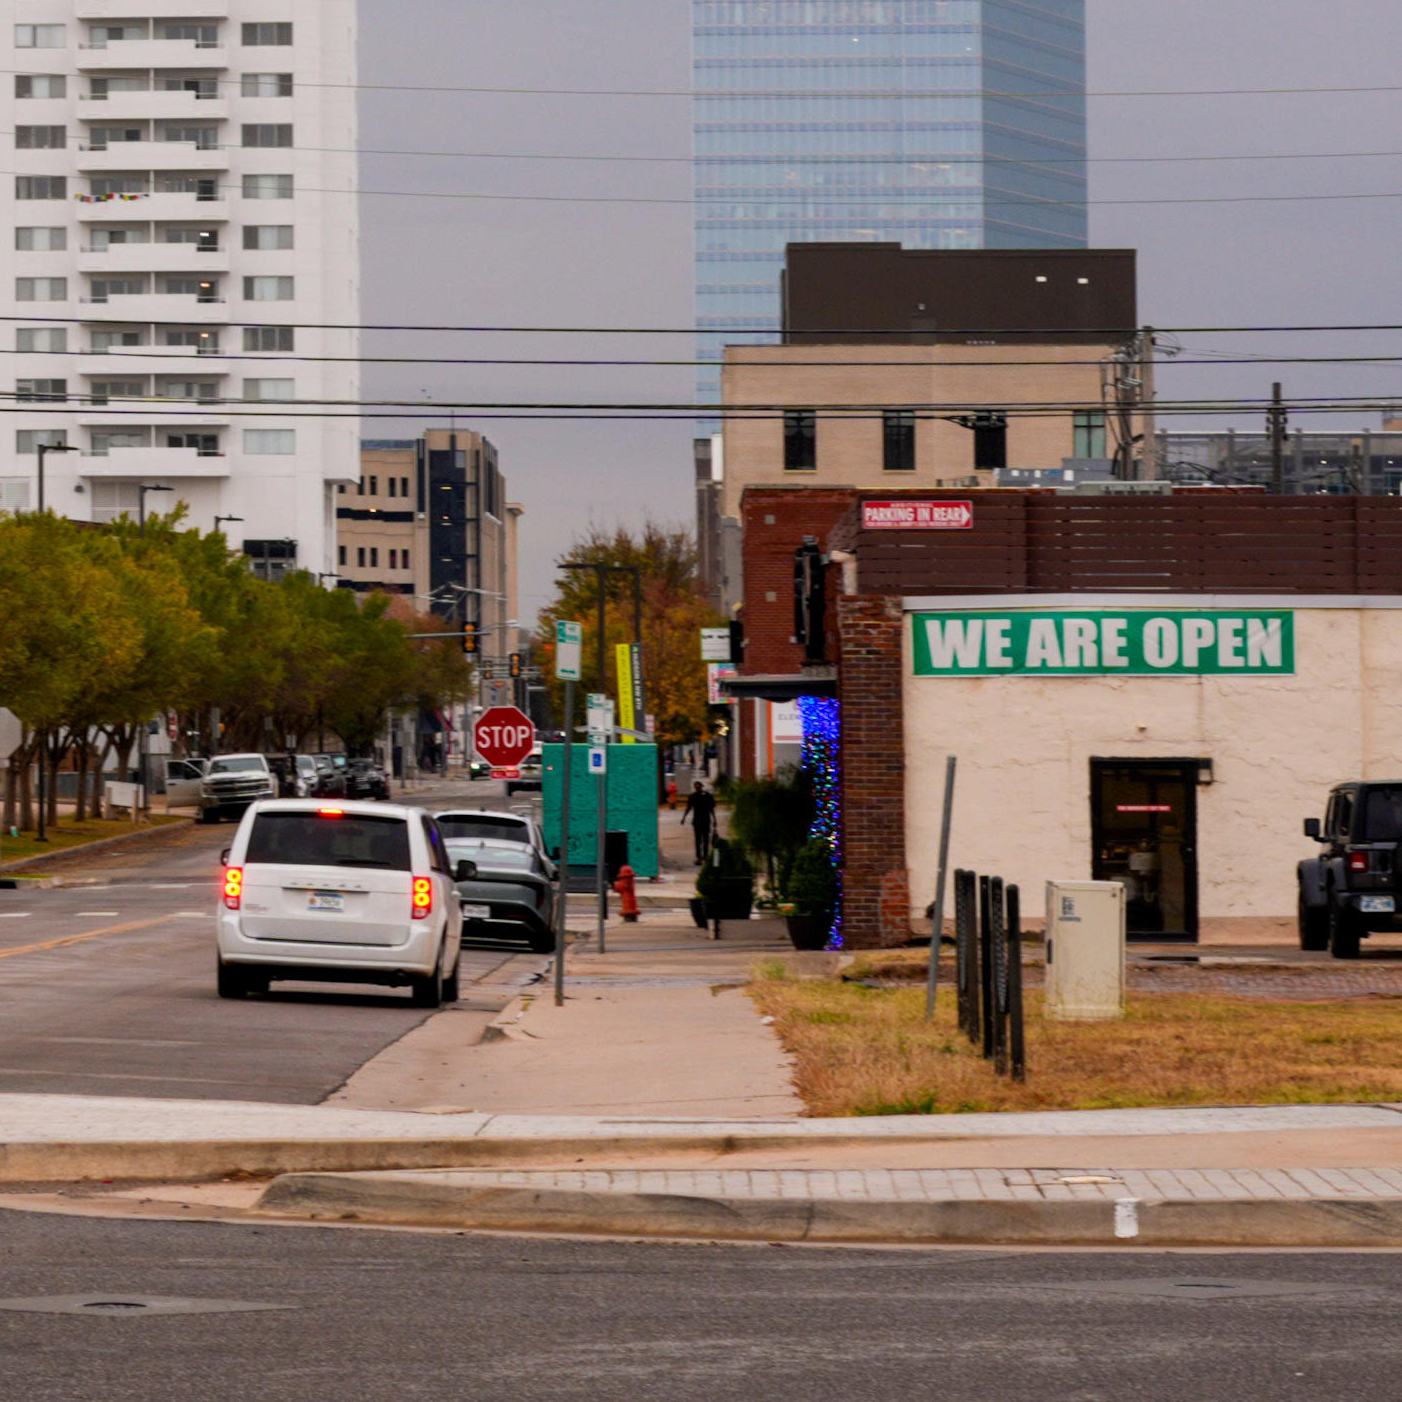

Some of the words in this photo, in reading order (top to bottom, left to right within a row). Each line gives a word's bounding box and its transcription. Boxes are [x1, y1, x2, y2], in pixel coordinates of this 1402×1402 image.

[865, 506, 915, 522] PARKING
[916, 506, 932, 522] IN
[932, 506, 963, 522] REAR
[924, 618, 1014, 670] WE
[1025, 617, 1128, 669] ARE
[1142, 616, 1284, 669] OPEN
[477, 726, 531, 749] STOP
